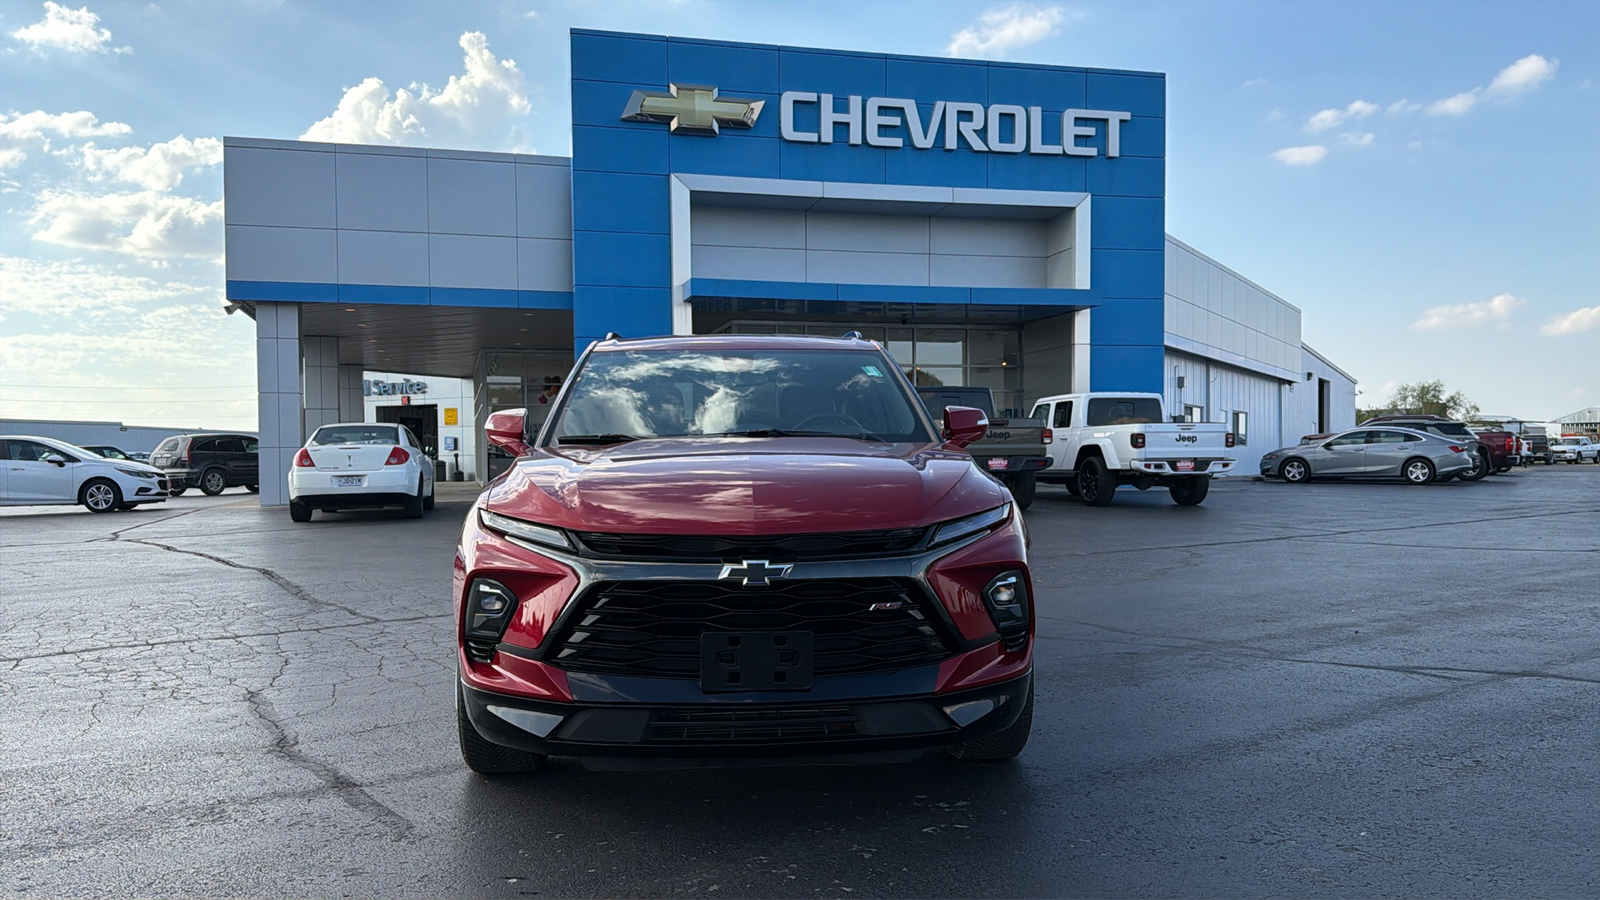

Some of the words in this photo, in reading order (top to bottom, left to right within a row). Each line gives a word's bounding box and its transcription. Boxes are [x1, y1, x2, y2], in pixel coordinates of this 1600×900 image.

[779, 90, 1132, 158] CHEVROLET
[372, 378, 428, 396] Service
[985, 429, 1011, 441] Jeep
[1175, 433, 1198, 444] Jeep
[869, 601, 903, 611] RS
